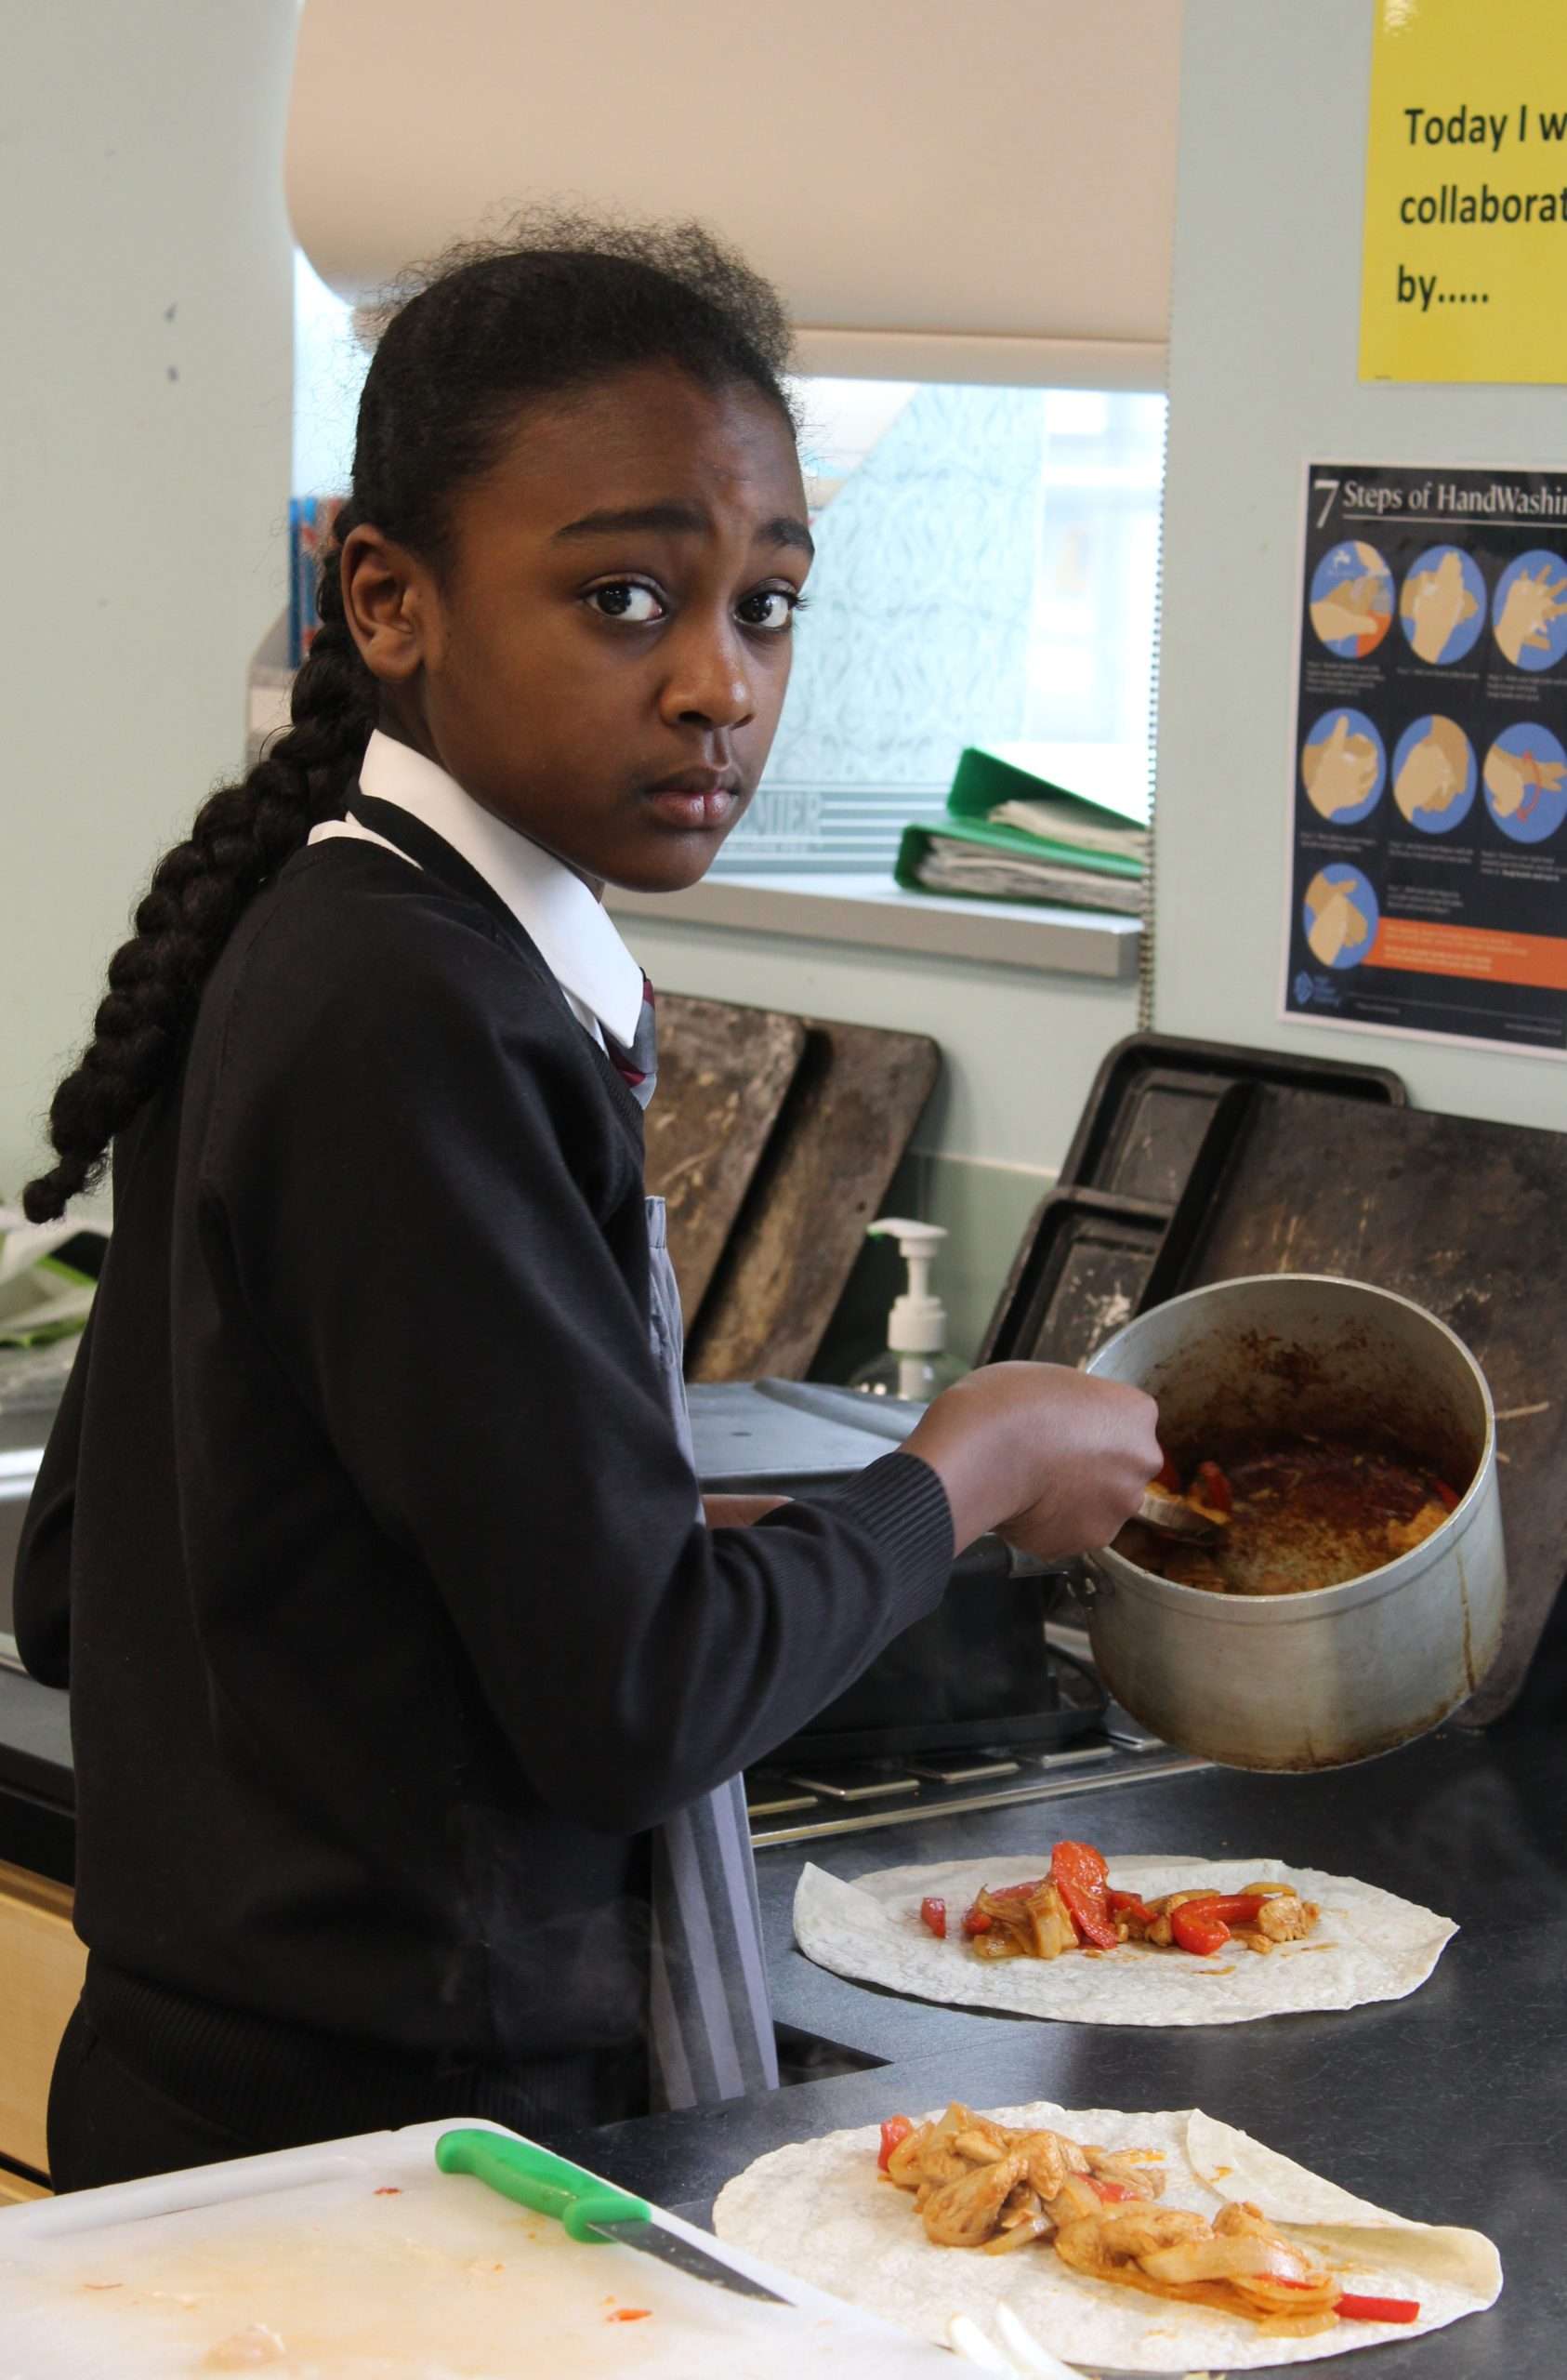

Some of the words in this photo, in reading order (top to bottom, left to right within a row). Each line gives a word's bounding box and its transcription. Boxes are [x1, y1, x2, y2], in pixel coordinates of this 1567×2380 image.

[1404, 104, 1508, 152] Today
[1519, 104, 1527, 141] I
[1397, 264, 1489, 311] by.....
[1313, 479, 1341, 529] 7
[1343, 481, 1403, 515] Steps
[1408, 482, 1432, 510] of
